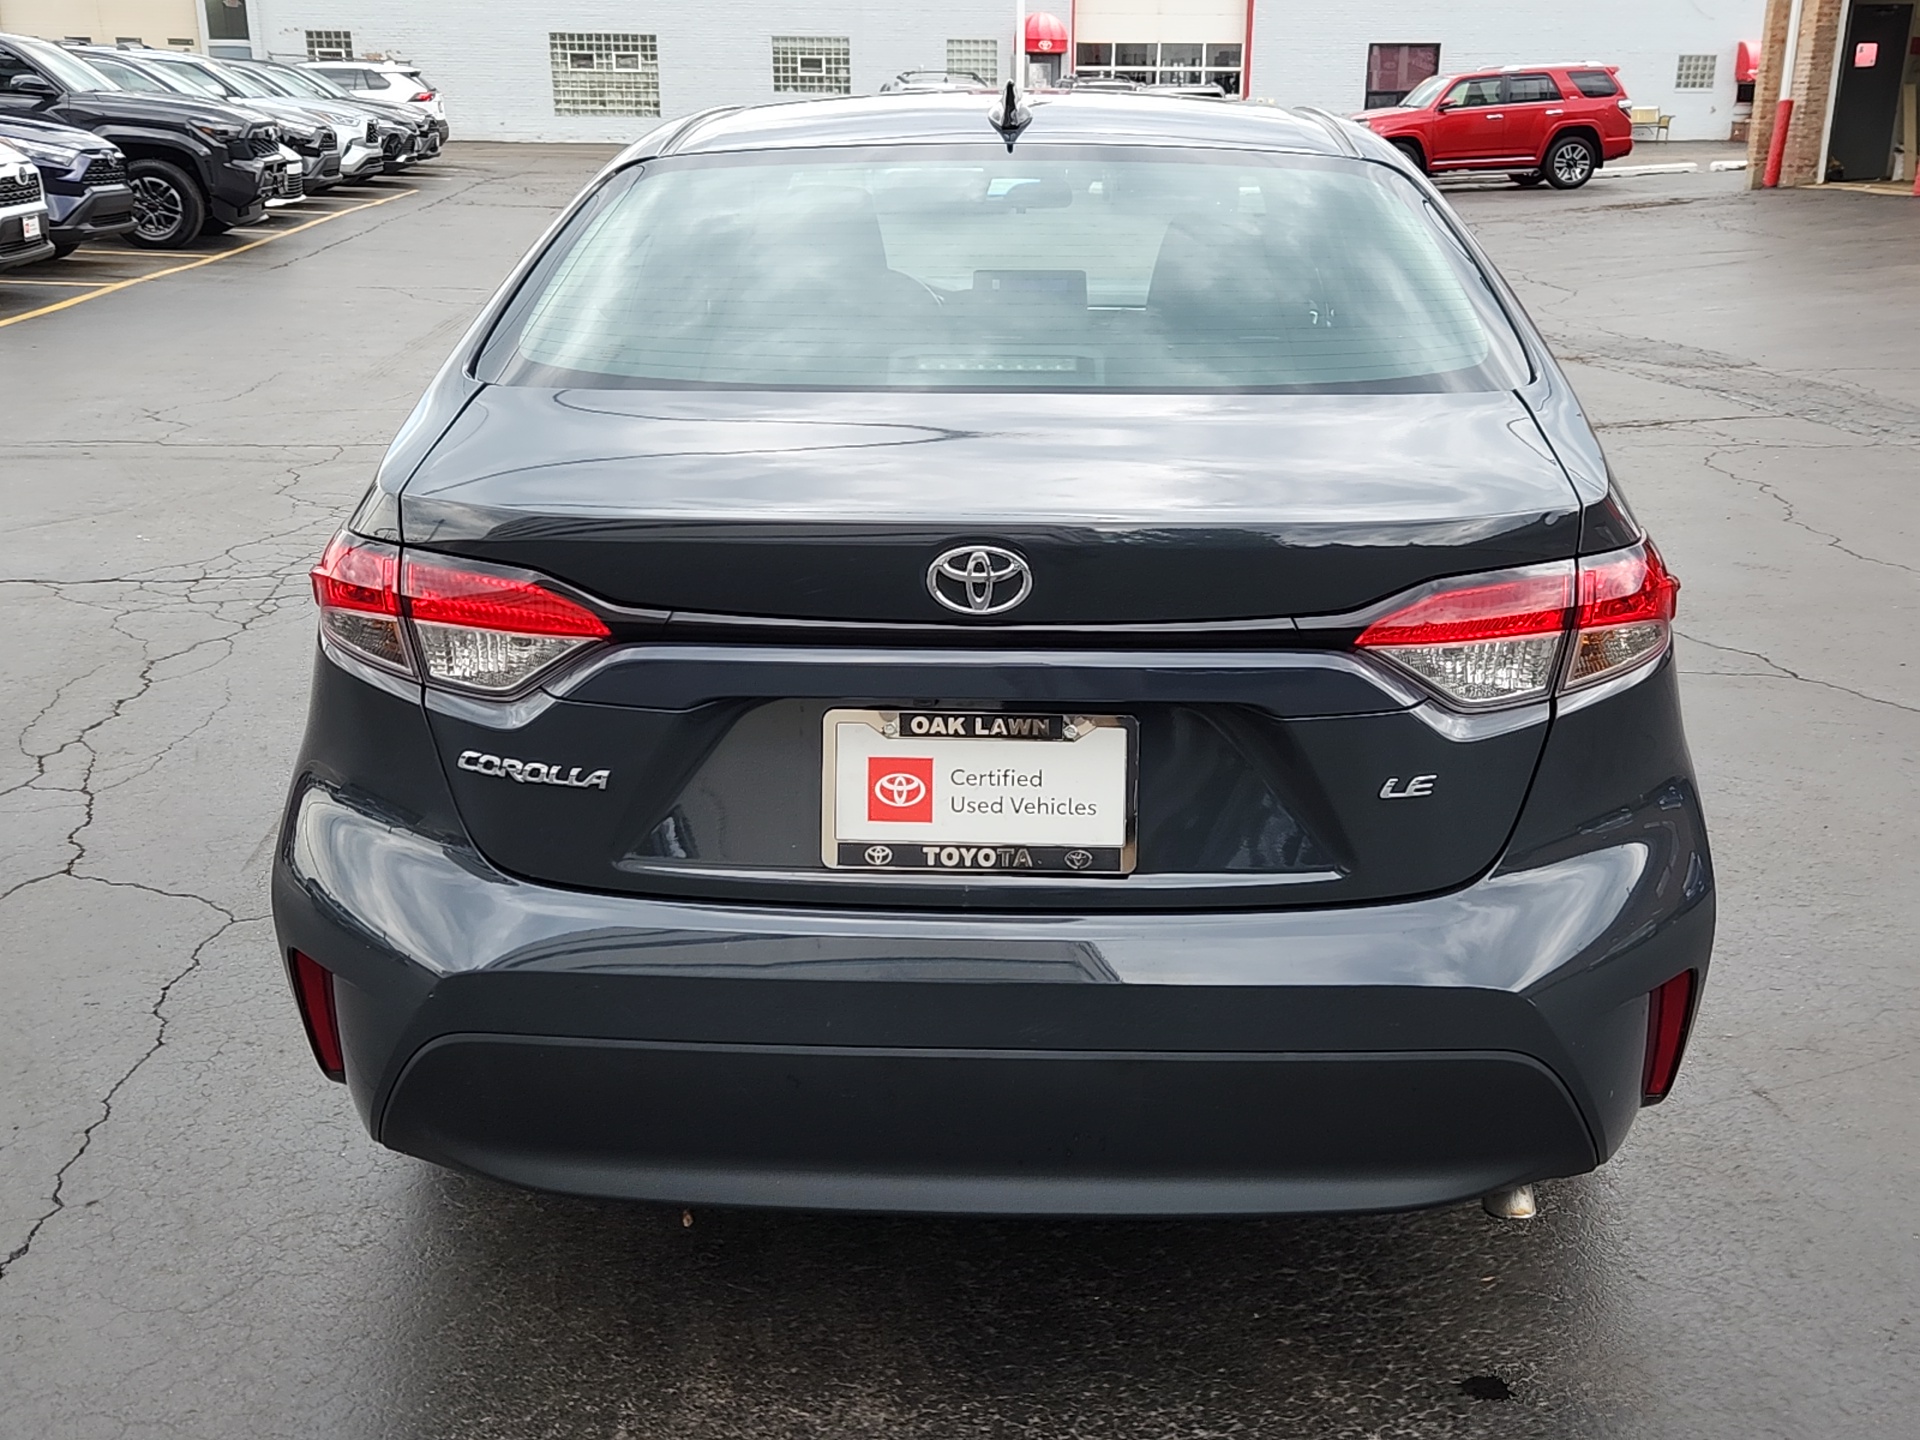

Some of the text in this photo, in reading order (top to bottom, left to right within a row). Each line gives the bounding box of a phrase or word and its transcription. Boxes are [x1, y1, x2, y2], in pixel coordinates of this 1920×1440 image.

[910, 716, 1050, 736] OAK LAWN
[457, 750, 611, 789] COROLLA
[950, 768, 1043, 787] Certified
[1379, 774, 1438, 799] LE
[951, 795, 1097, 816] Used Vehicles
[922, 846, 1033, 868] TOYOTA
